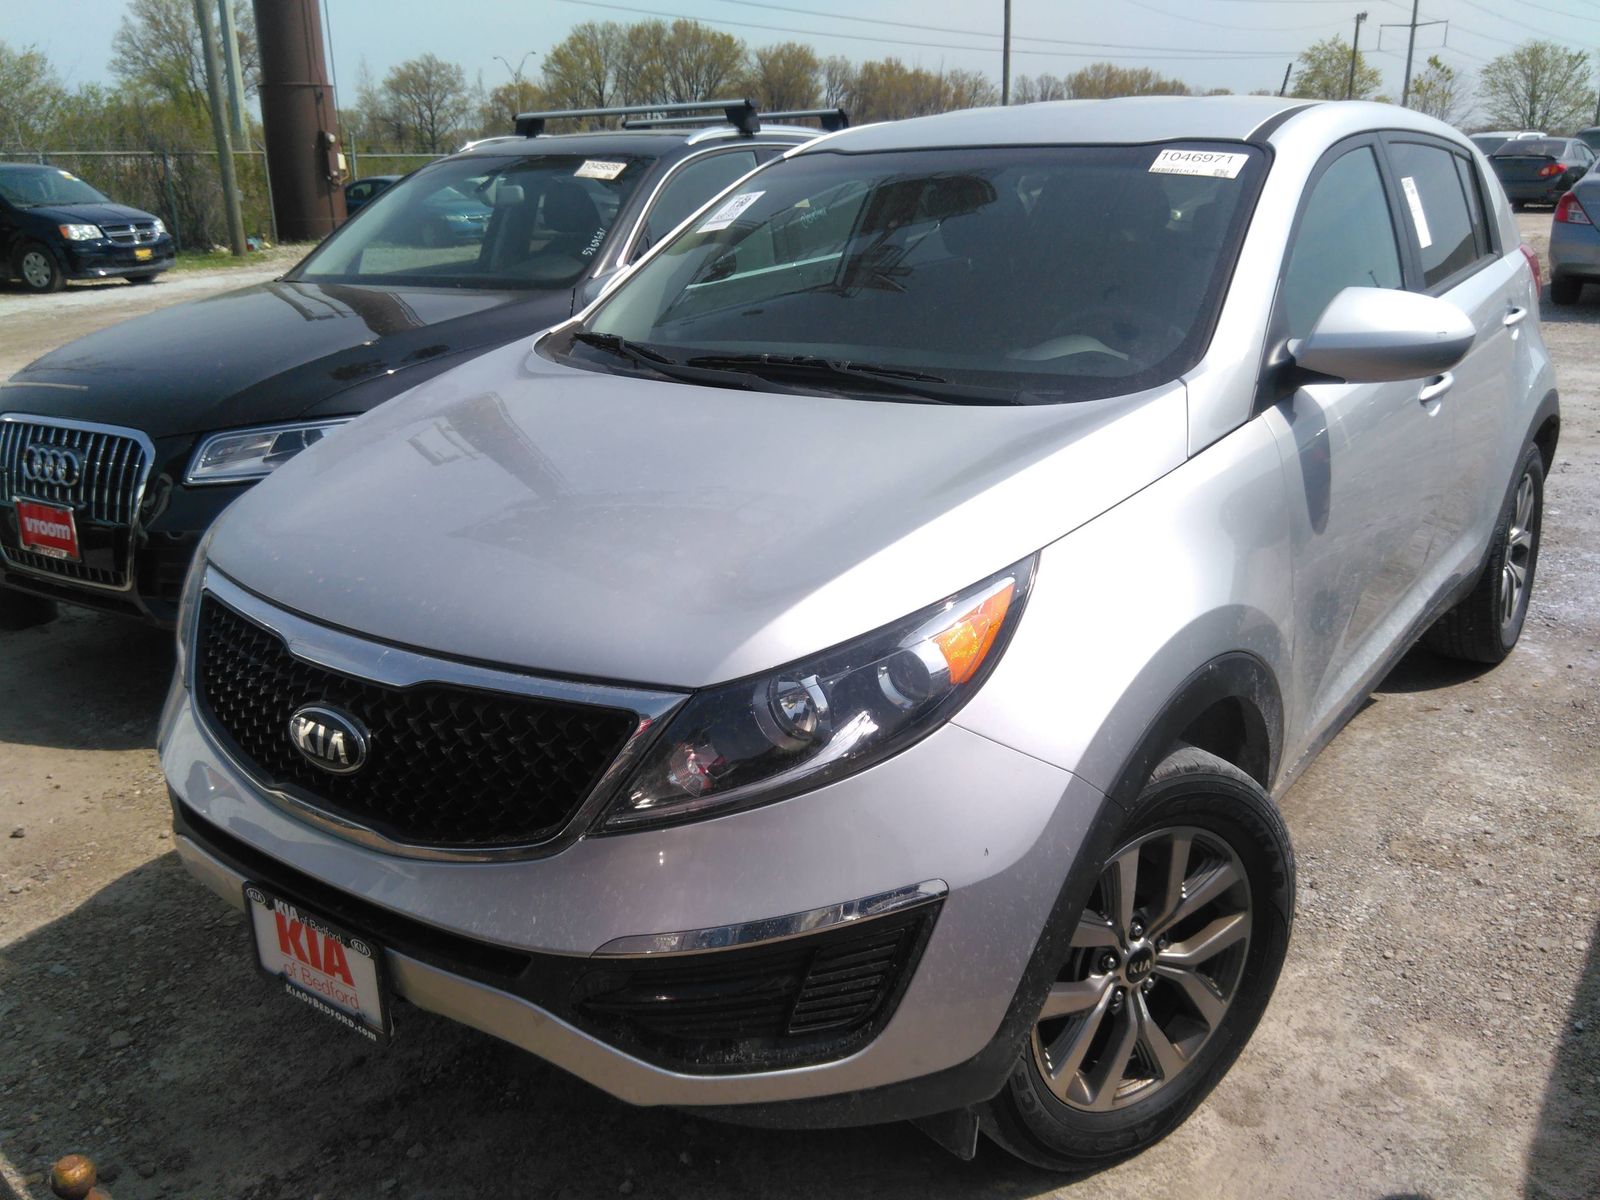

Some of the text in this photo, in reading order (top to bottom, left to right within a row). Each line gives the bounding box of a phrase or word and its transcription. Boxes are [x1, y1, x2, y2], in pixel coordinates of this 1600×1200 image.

[1162, 151, 1234, 164] 1046971
[24, 516, 71, 540] vroom
[298, 716, 349, 765] KIA
[274, 898, 300, 923] KIA
[309, 919, 342, 944] Bedford
[275, 911, 356, 988] KIA
[1129, 959, 1151, 974] KIA
[283, 960, 360, 1010] of Bedford
